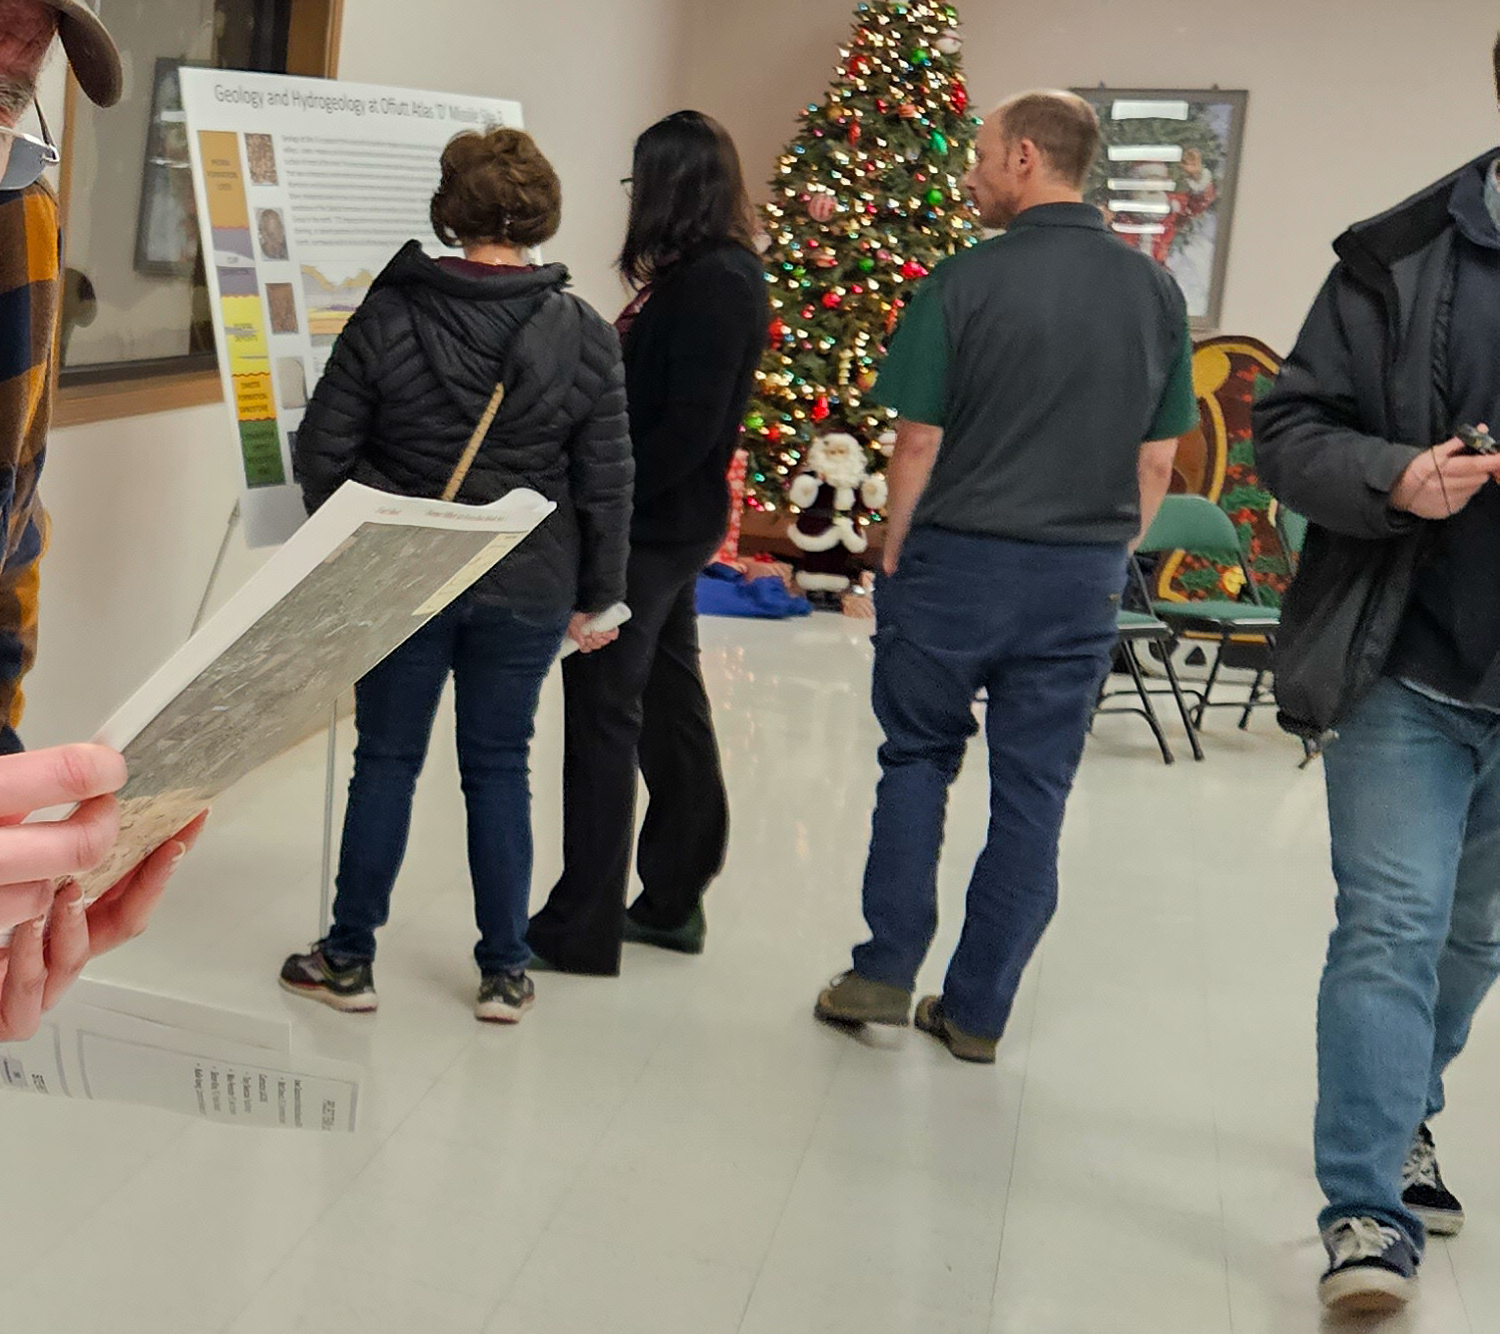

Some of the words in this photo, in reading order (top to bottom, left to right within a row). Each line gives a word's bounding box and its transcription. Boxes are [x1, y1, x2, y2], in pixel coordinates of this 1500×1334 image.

[214, 84, 264, 108] Geology
[267, 89, 289, 106] and
[291, 90, 366, 117] Hydrogeology
